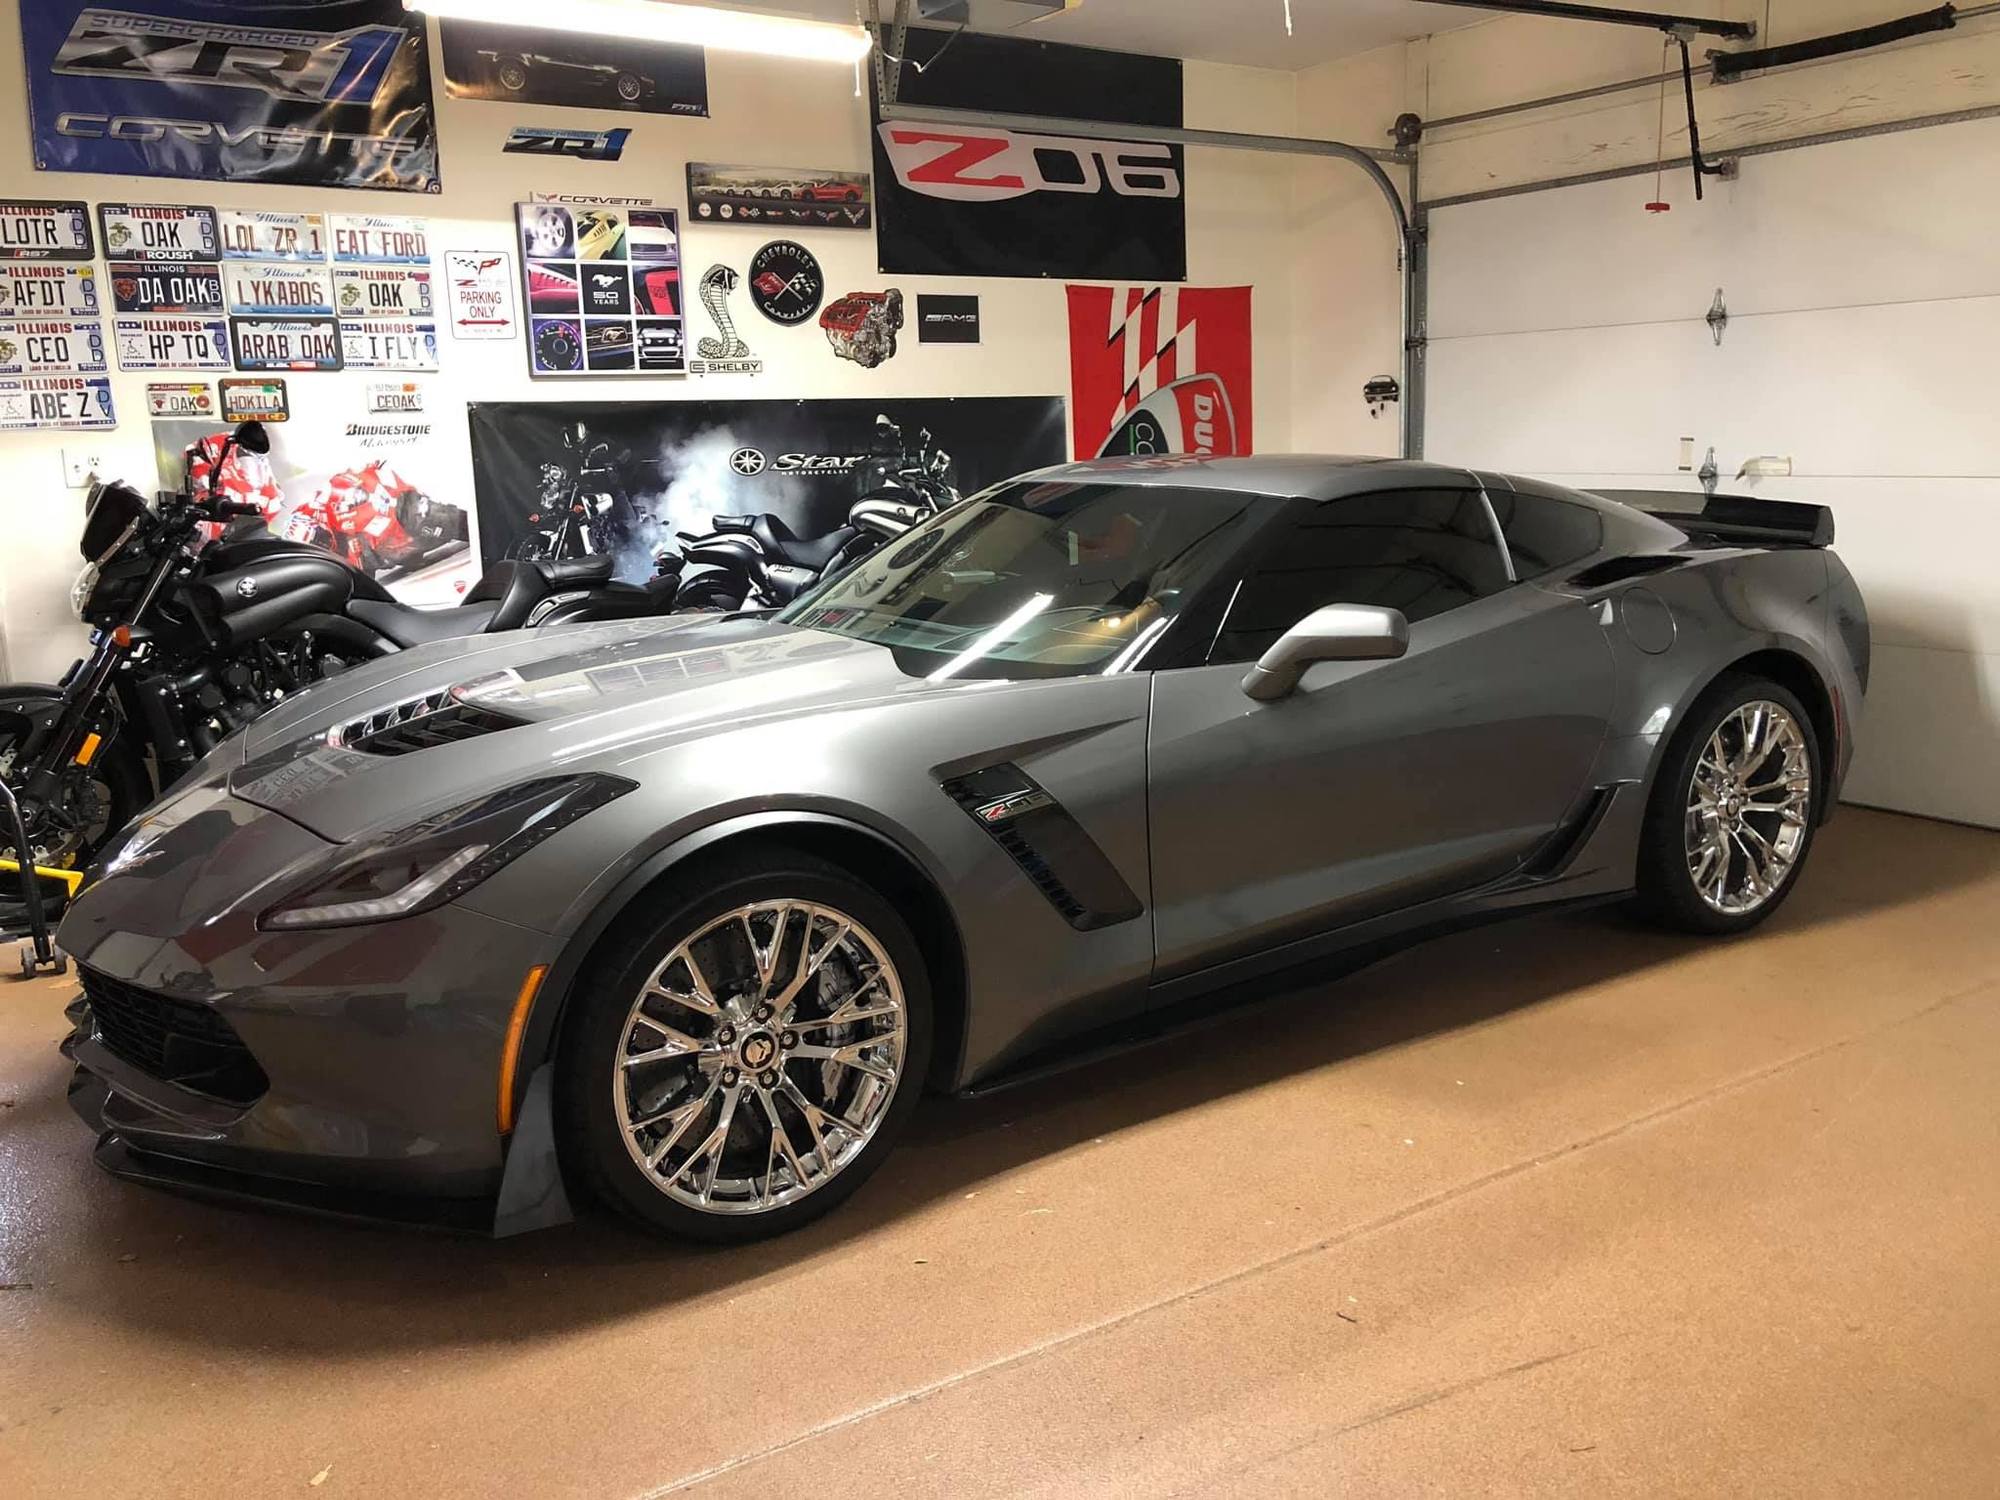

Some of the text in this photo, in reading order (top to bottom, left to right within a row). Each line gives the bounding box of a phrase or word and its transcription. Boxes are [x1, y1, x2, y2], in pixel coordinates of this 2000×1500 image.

[90, 15, 319, 47] SUPERCHARGED
[63, 24, 405, 102] ZR1
[55, 112, 418, 155] CORVETTE
[506, 128, 632, 158] ZR1
[886, 125, 1181, 199] Z06
[559, 195, 654, 206] CORVETTE
[131, 208, 185, 219] ILLINOIS
[1, 217, 58, 244] LOTR
[141, 222, 182, 248] OAK
[224, 224, 323, 255] LOL ZR 1
[336, 229, 426, 257] EAT FORD
[147, 250, 194, 260] ROUSH
[757, 245, 815, 269] CHEVROLET
[9, 266, 65, 278] ILLINOIS
[144, 264, 185, 273] ILLINOIS
[263, 267, 305, 278] Illinois
[359, 270, 406, 281] ILLINOIS
[14, 280, 66, 306] AFDT
[138, 277, 211, 304] DA OAK
[237, 280, 324, 306] LYKABOS
[368, 282, 403, 307] OAK
[460, 290, 502, 305] PARKING
[593, 291, 618, 299] 50
[469, 305, 496, 319] ONLY
[16, 323, 73, 334] ILLINOIS
[143, 320, 202, 332] ILLINOIS
[363, 323, 415, 333] ILLINOIS
[26, 336, 70, 363] CEO
[148, 334, 209, 360] HP TQ
[242, 334, 337, 360] ARAB OAK
[368, 336, 418, 360] I FLY
[708, 363, 759, 371] SHELBY
[22, 379, 85, 391] ILLINOIS
[30, 392, 92, 419] ABE Z
[170, 396, 197, 411] OAK
[377, 394, 417, 409] CEOAK
[345, 424, 432, 436] BRIDGESTONE
[769, 453, 866, 470] Star
